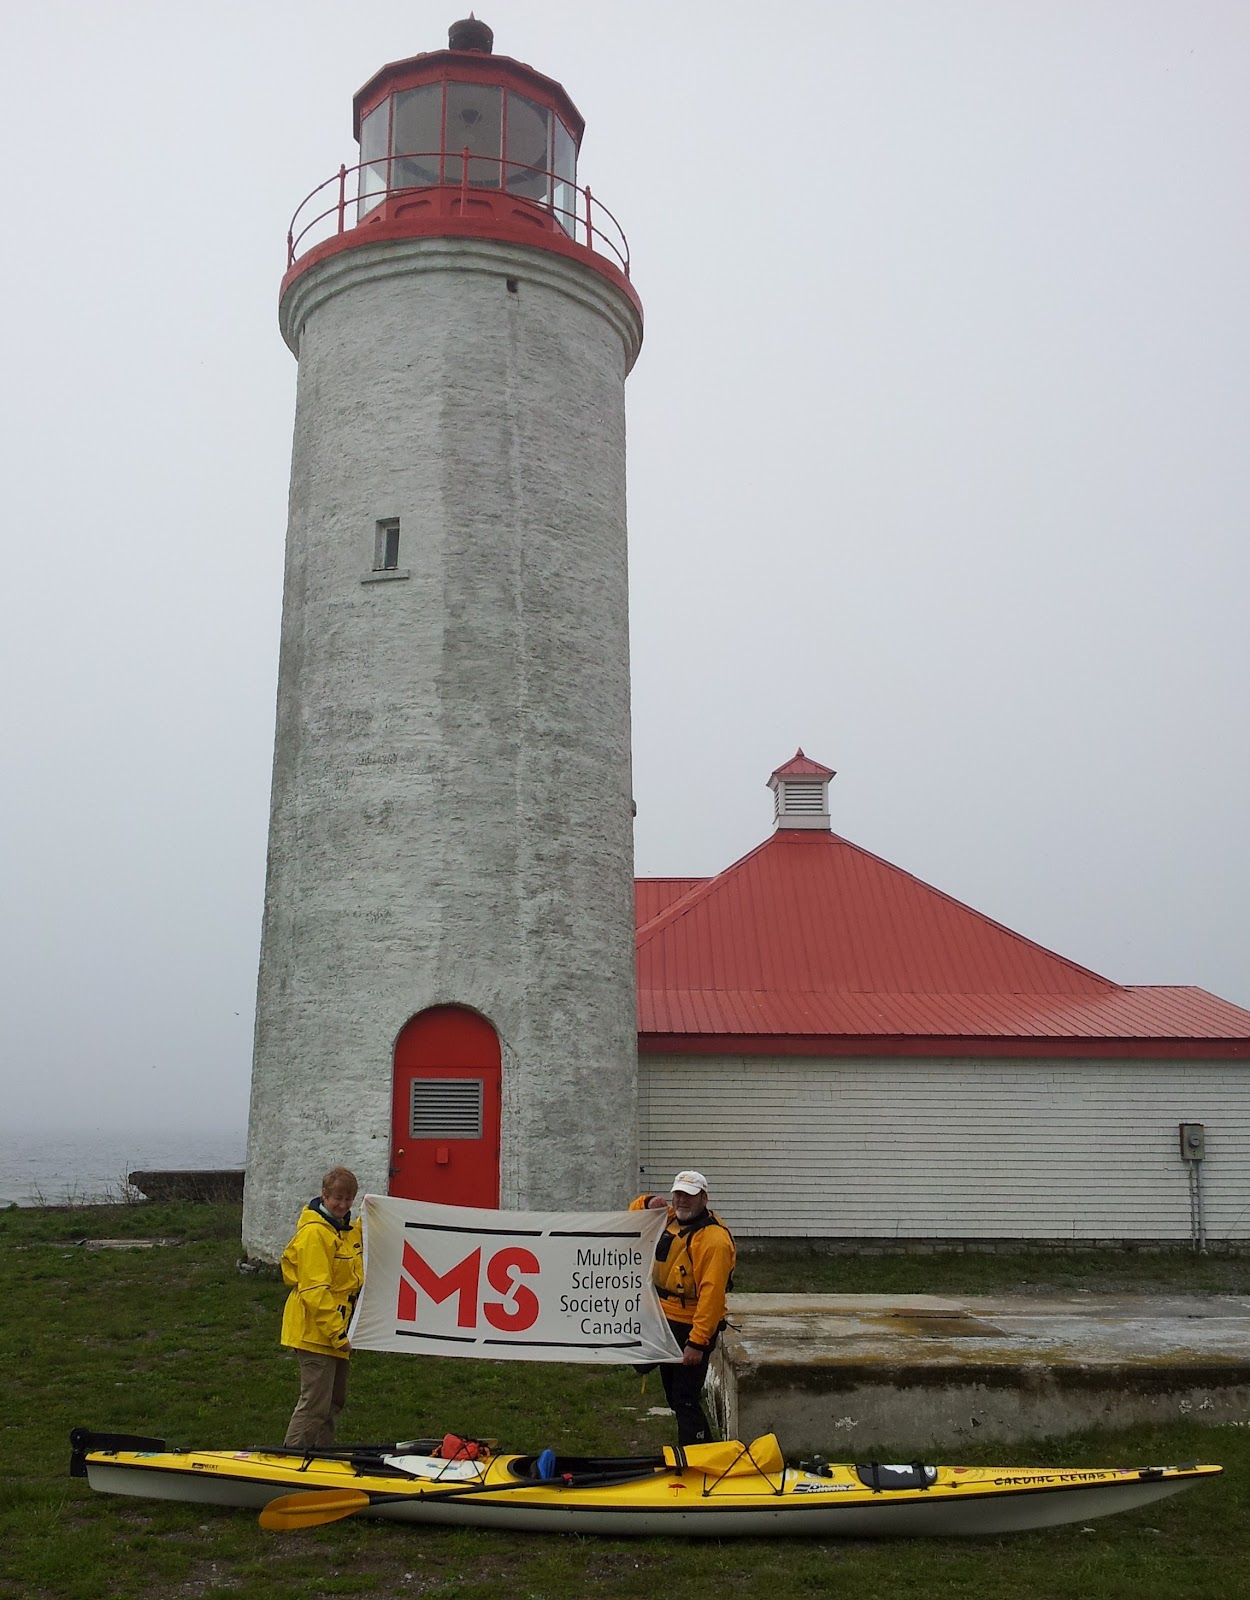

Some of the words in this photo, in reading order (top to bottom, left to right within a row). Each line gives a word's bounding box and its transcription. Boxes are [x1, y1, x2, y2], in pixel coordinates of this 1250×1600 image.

[577, 1248, 642, 1270] Multiple
[397, 1239, 540, 1332] MS
[572, 1271, 642, 1289] Sclerosis
[560, 1294, 620, 1317] Society
[625, 1293, 641, 1312] of
[581, 1317, 641, 1334] Canada
[1060, 1473, 1106, 1482] REHAB
